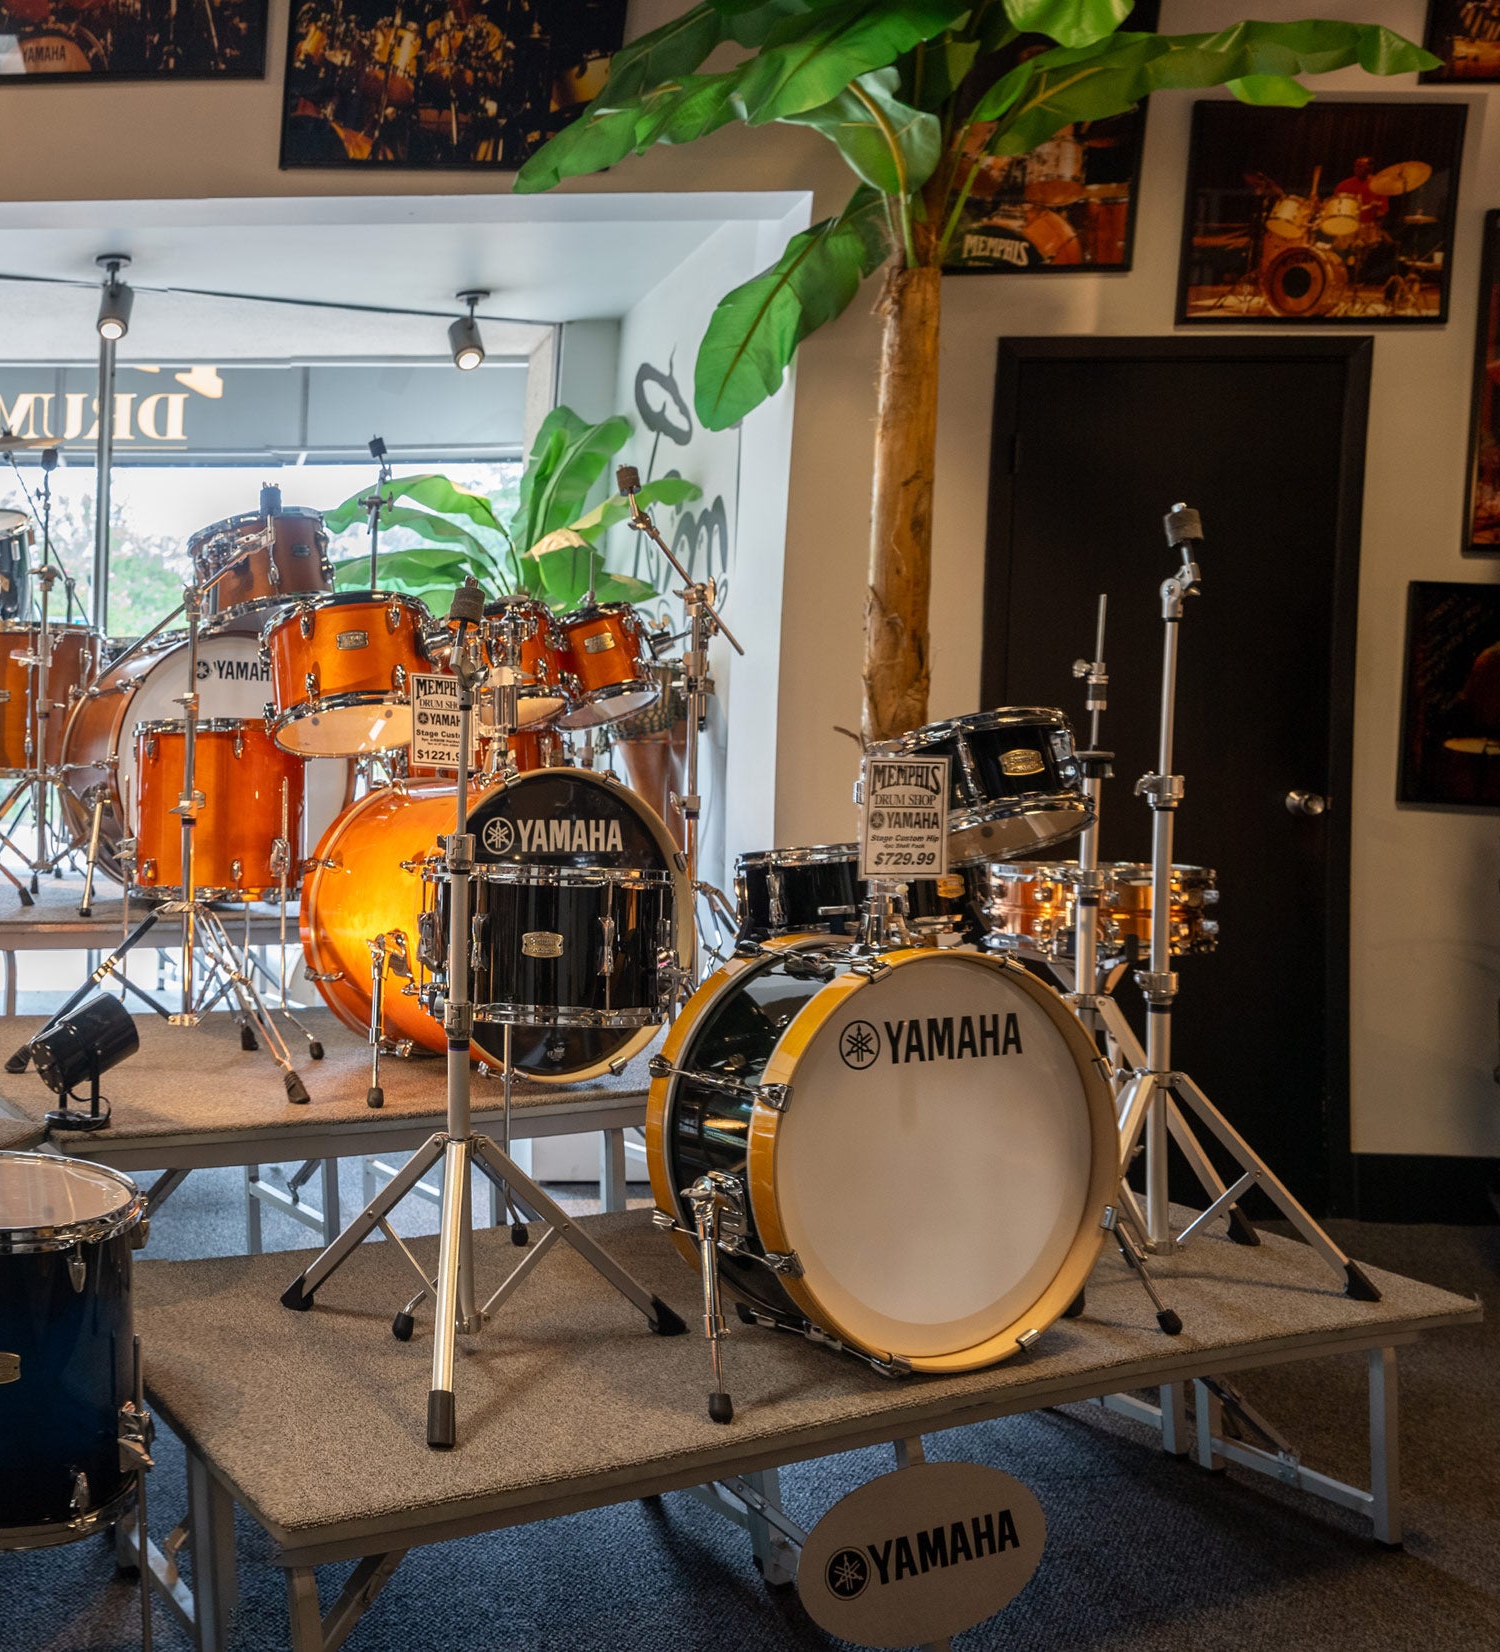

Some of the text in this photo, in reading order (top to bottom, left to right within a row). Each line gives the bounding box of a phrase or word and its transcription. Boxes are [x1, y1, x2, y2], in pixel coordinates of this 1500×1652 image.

[23, 44, 66, 62] YAMAHA
[962, 234, 1030, 267] MEMPHIS
[216, 660, 273, 682] YAMAH
[416, 678, 458, 700] MEMPH
[420, 699, 460, 709] DRUM SHO
[430, 712, 460, 727] YAMAH
[416, 729, 438, 738] Stage
[871, 765, 941, 796] MEMPHIS
[875, 794, 937, 806] DRUM SHOP
[887, 811, 940, 830] YAMAHA
[517, 819, 624, 852] YAMAHA
[871, 834, 940, 843] Stage Custom Hip
[874, 852, 936, 867] $729.99
[884, 1012, 1024, 1064] YAMAHA
[866, 1509, 1021, 1585] YAMAHA
